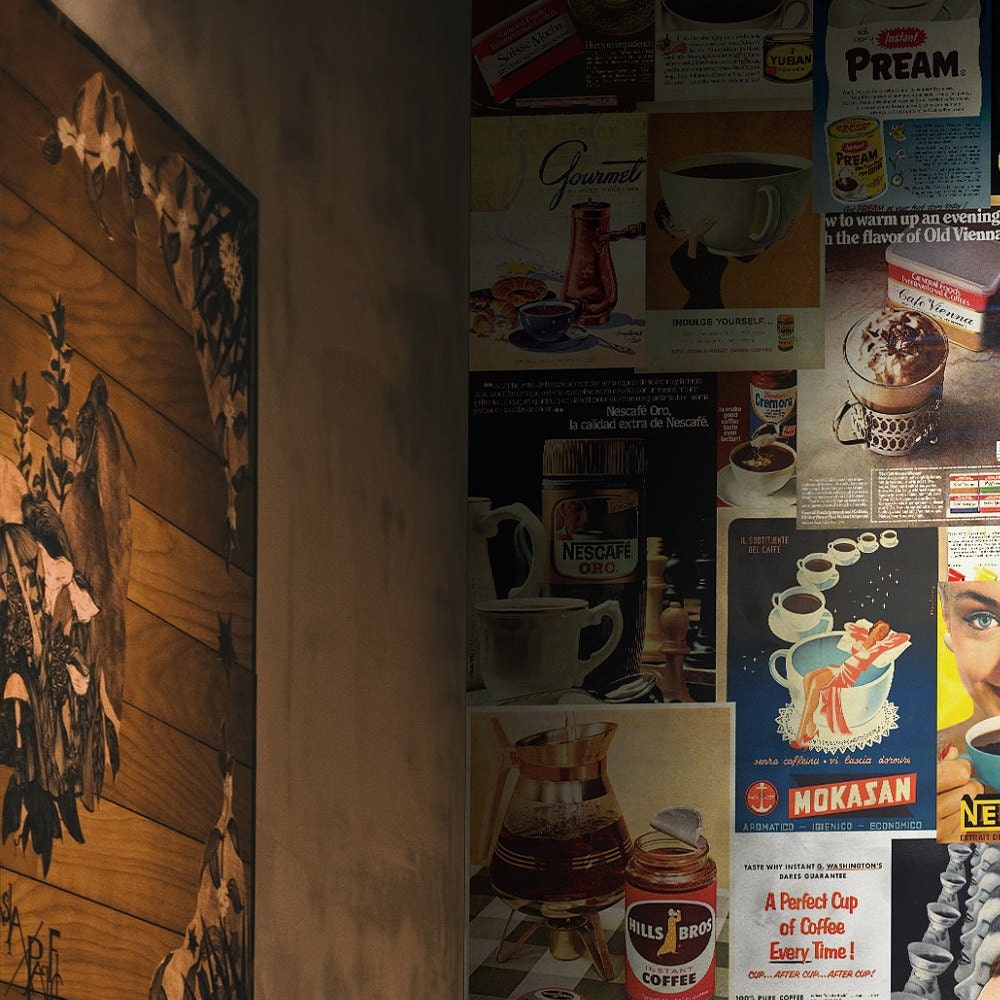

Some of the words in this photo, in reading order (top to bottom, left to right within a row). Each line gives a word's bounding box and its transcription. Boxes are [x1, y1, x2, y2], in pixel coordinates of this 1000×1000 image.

[883, 31, 918, 44] Instant
[769, 55, 811, 66] YUBAN
[845, 48, 958, 82] PREAM
[836, 150, 878, 166] PREAM
[539, 140, 646, 210] Gourmet
[840, 214, 853, 226] to
[857, 213, 897, 226] warm
[901, 212, 919, 228] up
[922, 212, 940, 224] an
[943, 209, 1000, 225] evening
[837, 231, 859, 244] the
[862, 230, 905, 244] flavor
[906, 229, 920, 243] of
[924, 227, 950, 242] Old
[672, 317, 712, 327] INDULGE
[755, 393, 793, 409] Cremora
[606, 405, 647, 416] Nescafé
[619, 419, 647, 429] extra
[650, 418, 663, 428] de
[794, 777, 911, 815] MOKASAN
[743, 823, 794, 831] AROMATICO
[765, 892, 776, 912] A
[780, 892, 827, 911] Perfect
[831, 891, 859, 914] Cup
[628, 917, 664, 940] HILLS
[679, 917, 712, 940] BROS
[779, 918, 796, 936] of
[800, 918, 845, 935] Coffee
[770, 942, 810, 965] Every
[642, 973, 697, 987] COFFEE
